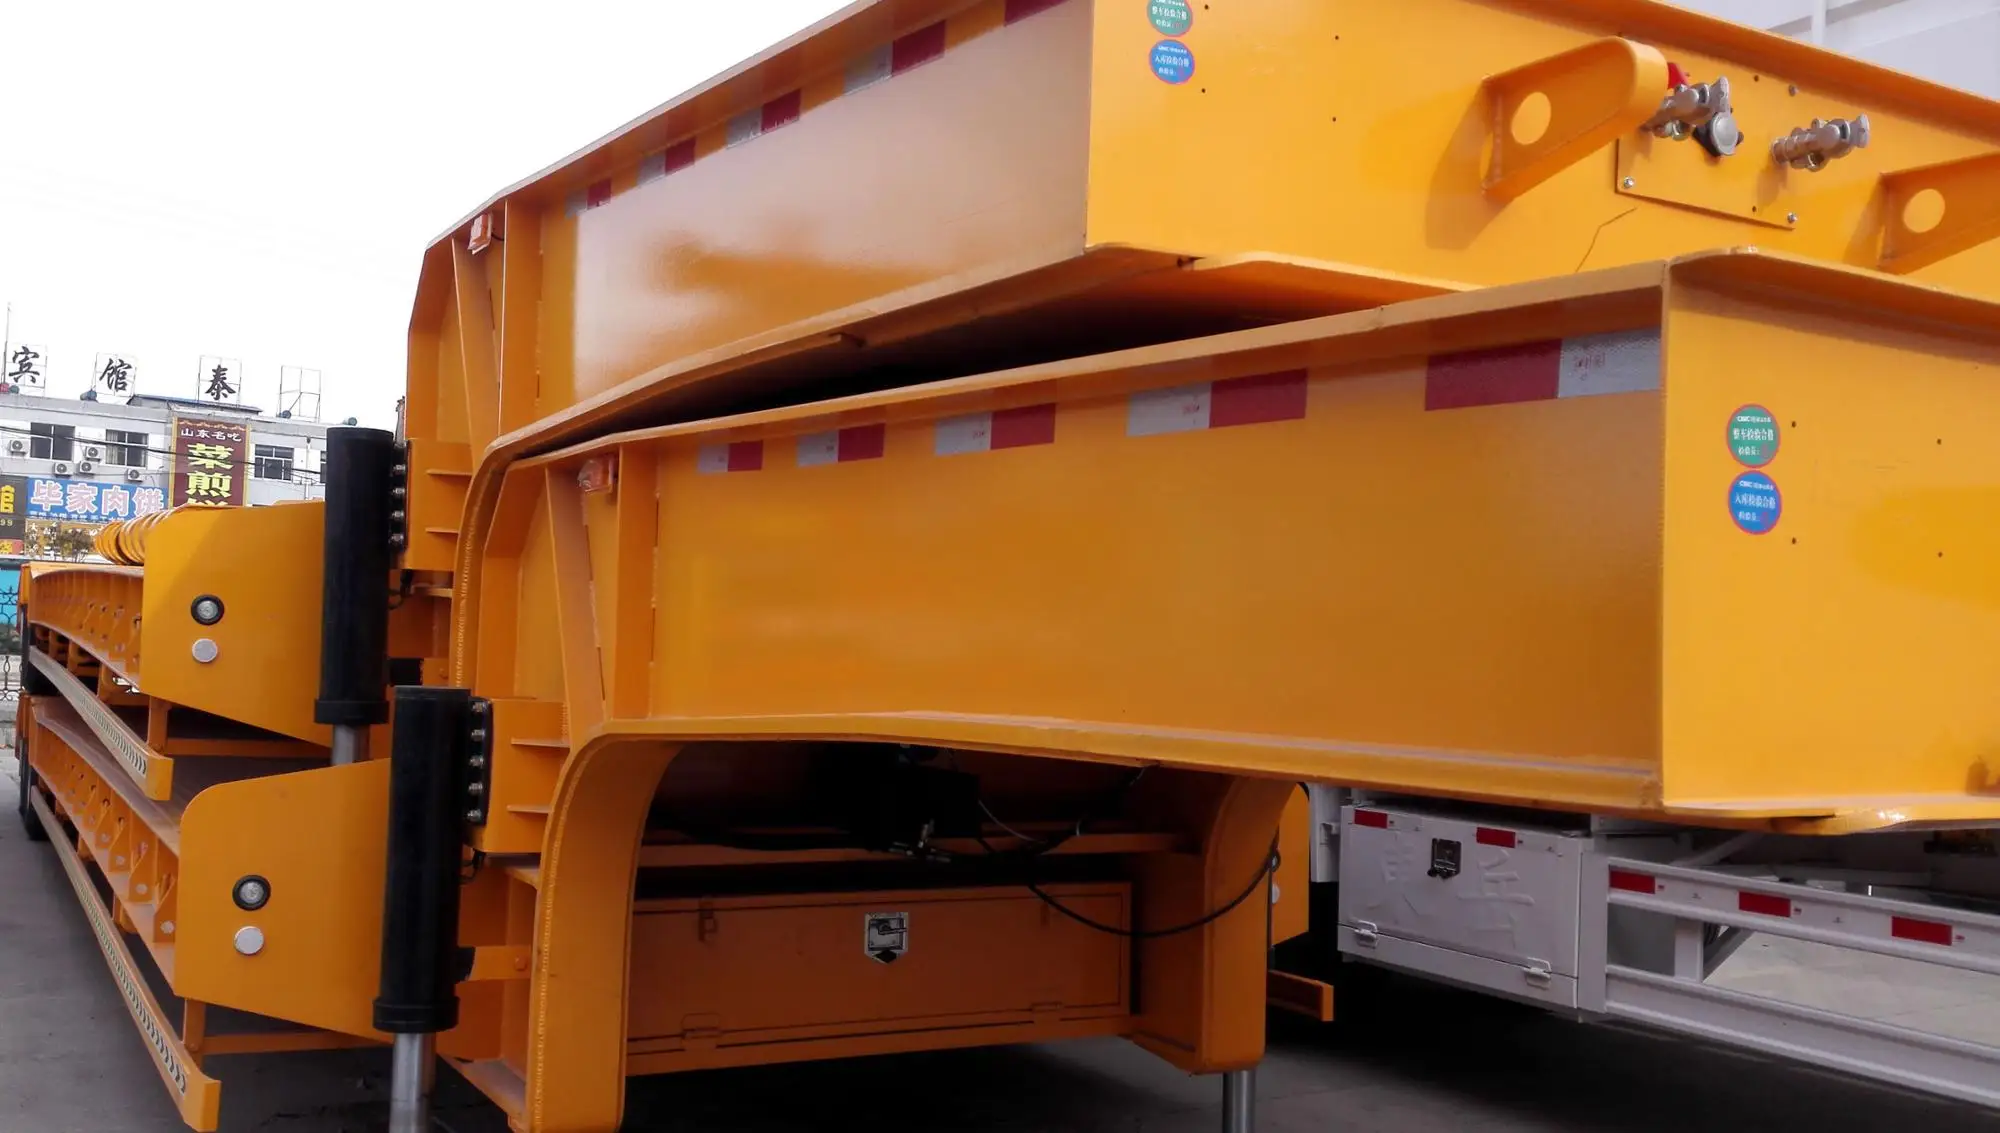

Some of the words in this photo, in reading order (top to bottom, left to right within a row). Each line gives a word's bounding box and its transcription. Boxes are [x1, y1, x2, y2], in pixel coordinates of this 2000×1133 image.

[181, 428, 242, 442] 山东名吃
[185, 442, 234, 506] 菜煎
[31, 480, 165, 517] 毕家肉饼
